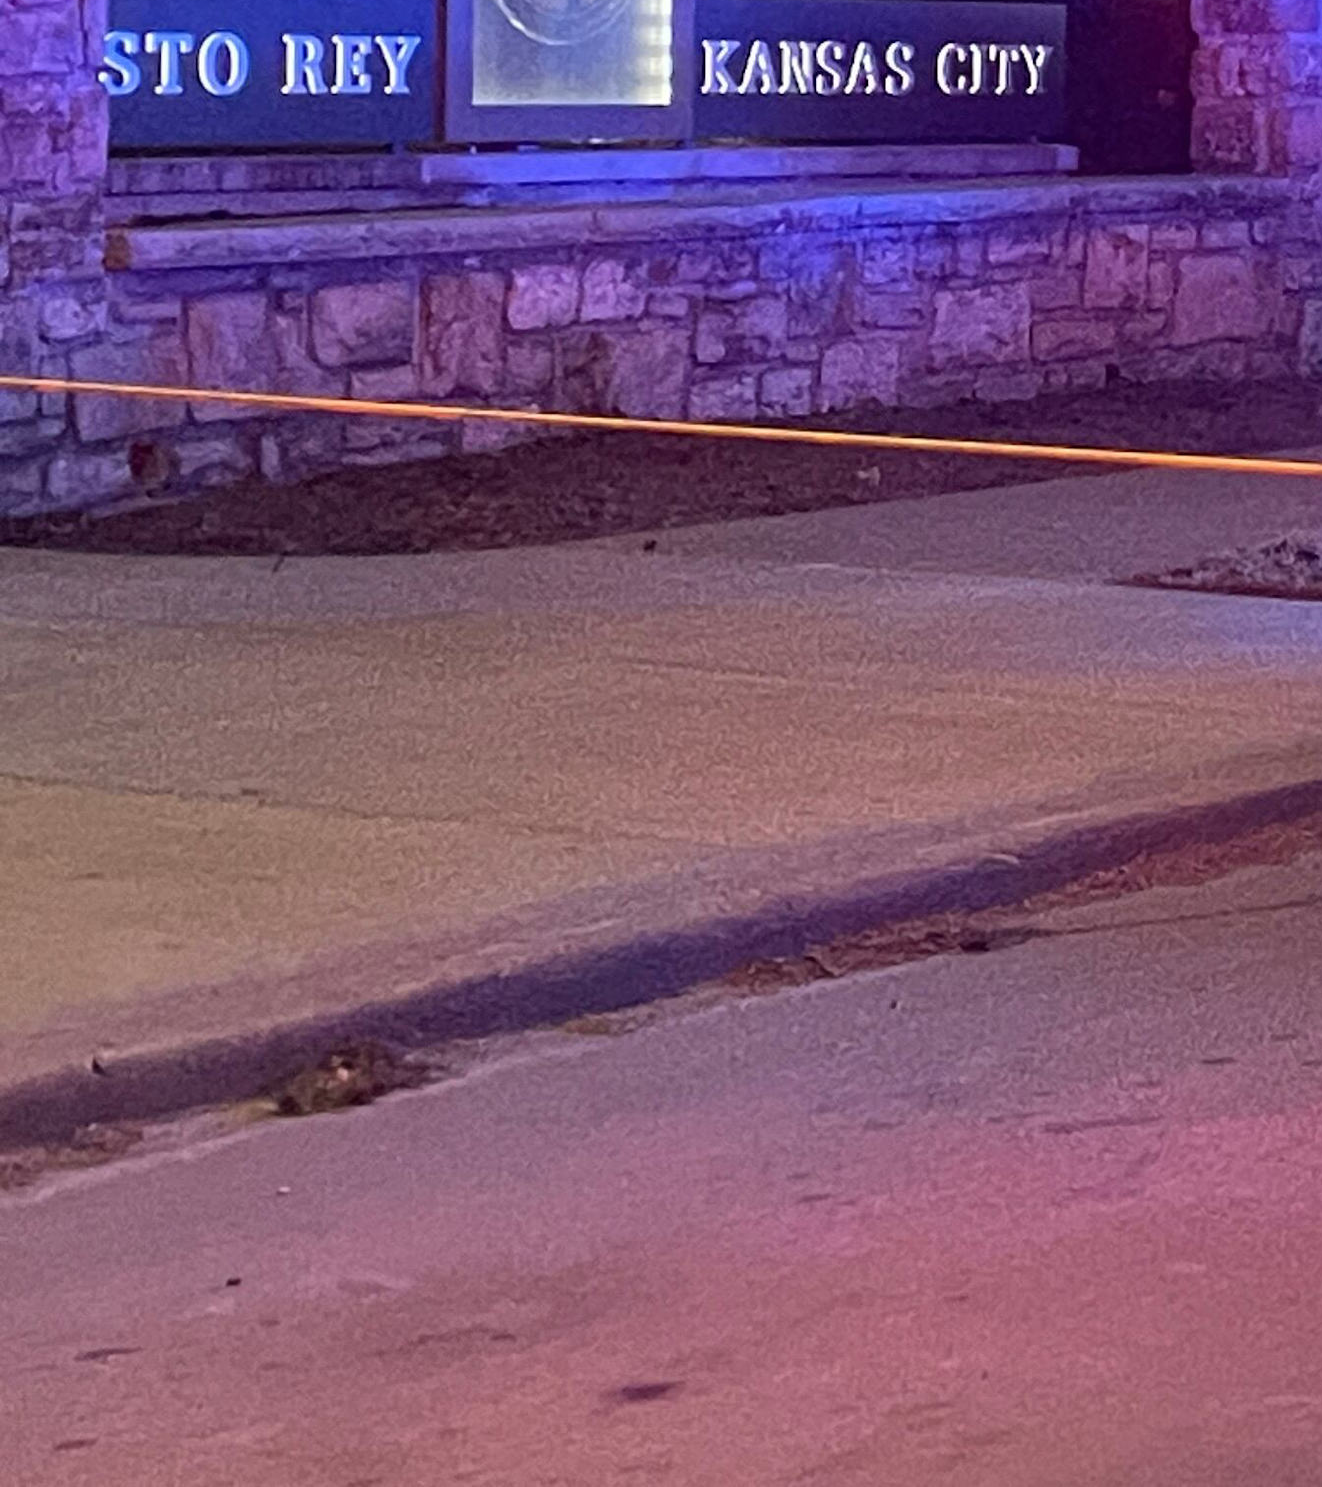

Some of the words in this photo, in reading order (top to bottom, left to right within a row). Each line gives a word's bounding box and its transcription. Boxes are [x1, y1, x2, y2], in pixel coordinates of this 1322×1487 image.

[98, 30, 249, 96] STO
[280, 33, 421, 95] REY
[699, 39, 914, 95] KANSAS
[936, 42, 1052, 95] CITY
